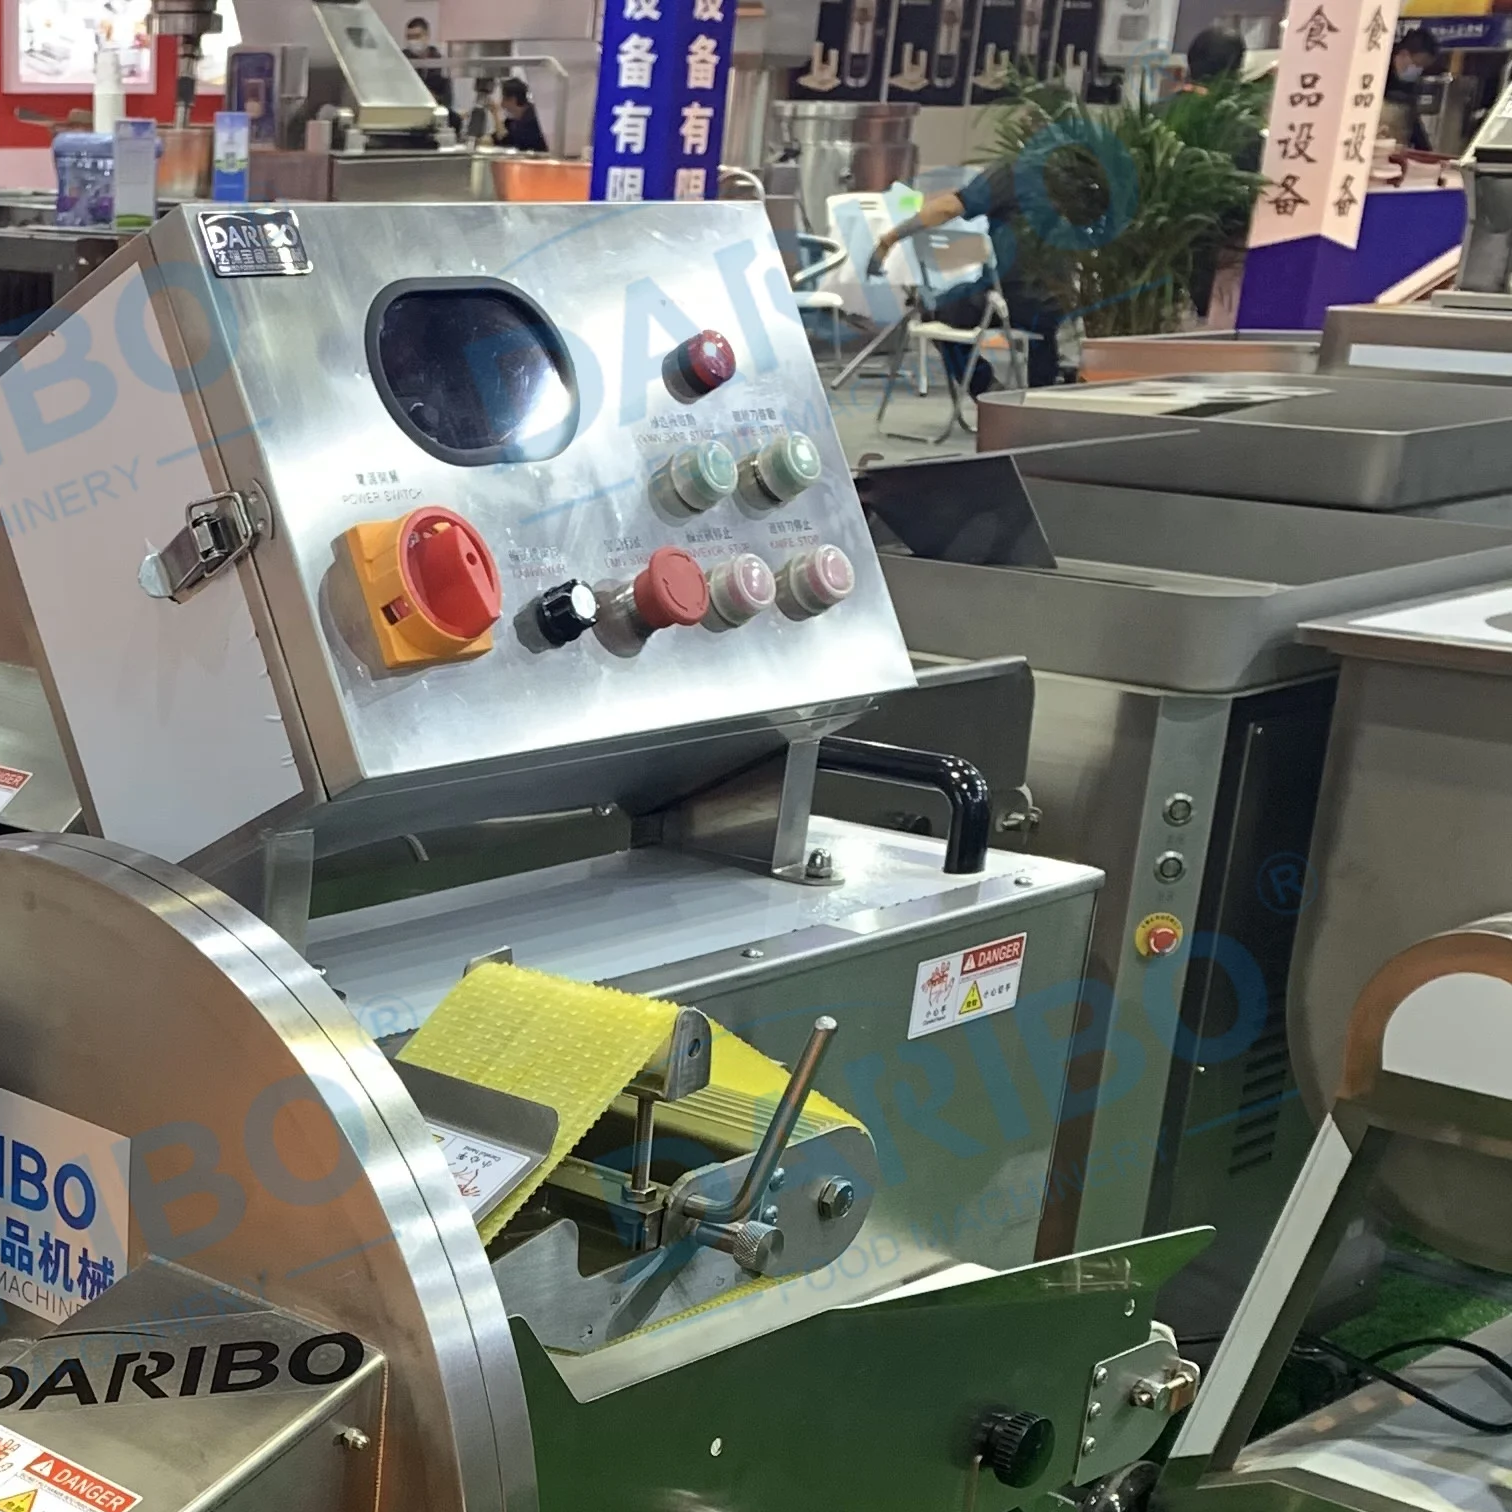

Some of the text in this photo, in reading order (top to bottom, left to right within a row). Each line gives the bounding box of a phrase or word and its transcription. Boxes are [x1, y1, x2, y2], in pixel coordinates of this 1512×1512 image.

[1268, 5, 1340, 216] 食品设备
[1335, 5, 1388, 217] 食品设备
[977, 942, 1021, 967] DANGER
[52, 1467, 126, 1512] DANGER
